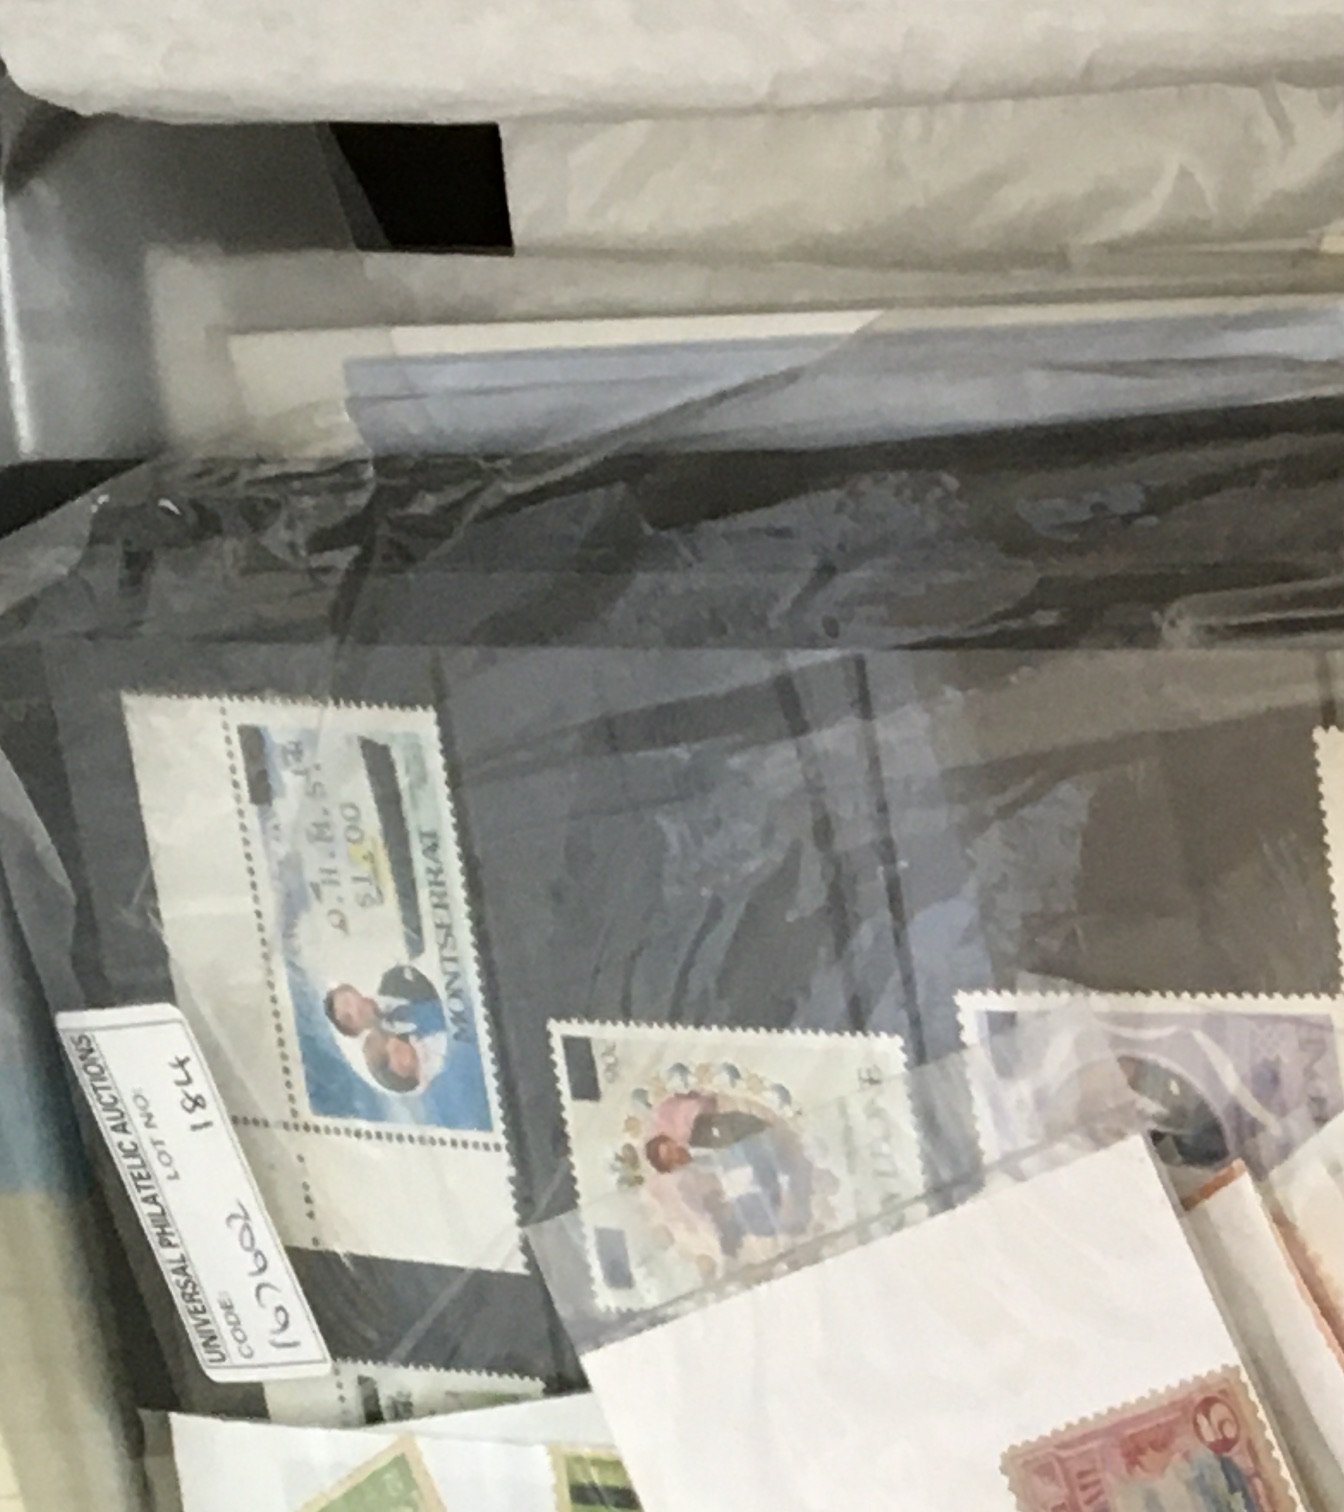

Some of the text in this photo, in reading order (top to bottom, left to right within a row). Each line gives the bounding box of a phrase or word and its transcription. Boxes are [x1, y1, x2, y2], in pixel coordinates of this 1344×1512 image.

[424, 829, 471, 1045] MONTSERRAT
[171, 1055, 213, 1132] 184
[151, 1137, 181, 1181] LOT
[72, 1035, 226, 1364] UNIVERSAL PHILATELIC AUCTIONS
[218, 1297, 255, 1360] CODE:
[1192, 1400, 1241, 1448] 5
